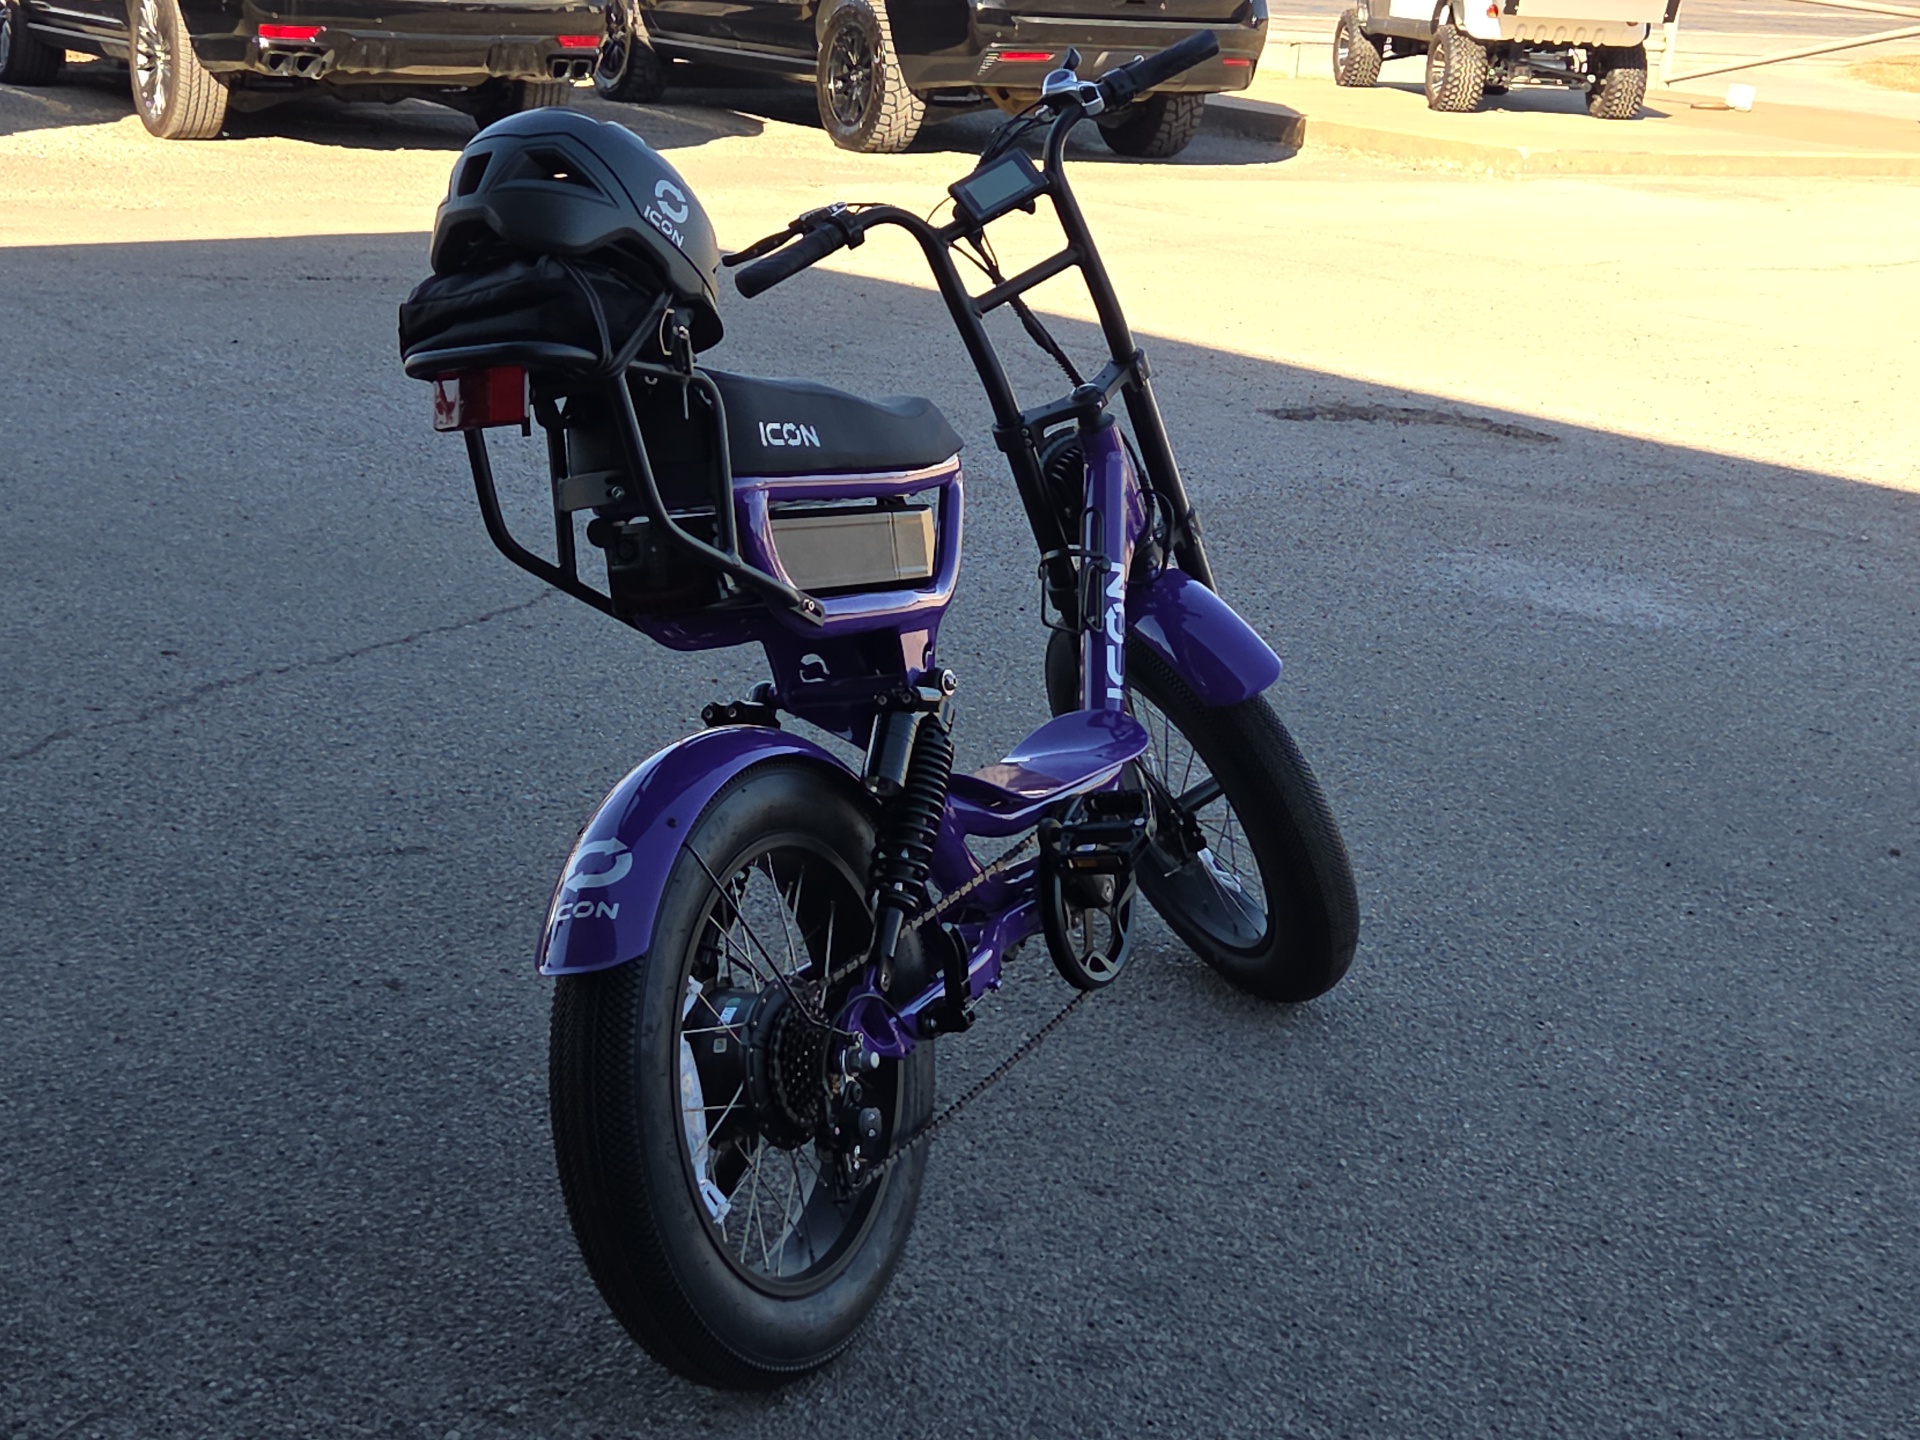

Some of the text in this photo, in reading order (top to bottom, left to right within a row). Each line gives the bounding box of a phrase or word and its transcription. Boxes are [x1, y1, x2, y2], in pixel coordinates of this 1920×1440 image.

[643, 205, 685, 247] ICON
[758, 421, 820, 447] ICON
[553, 900, 620, 921] CON
